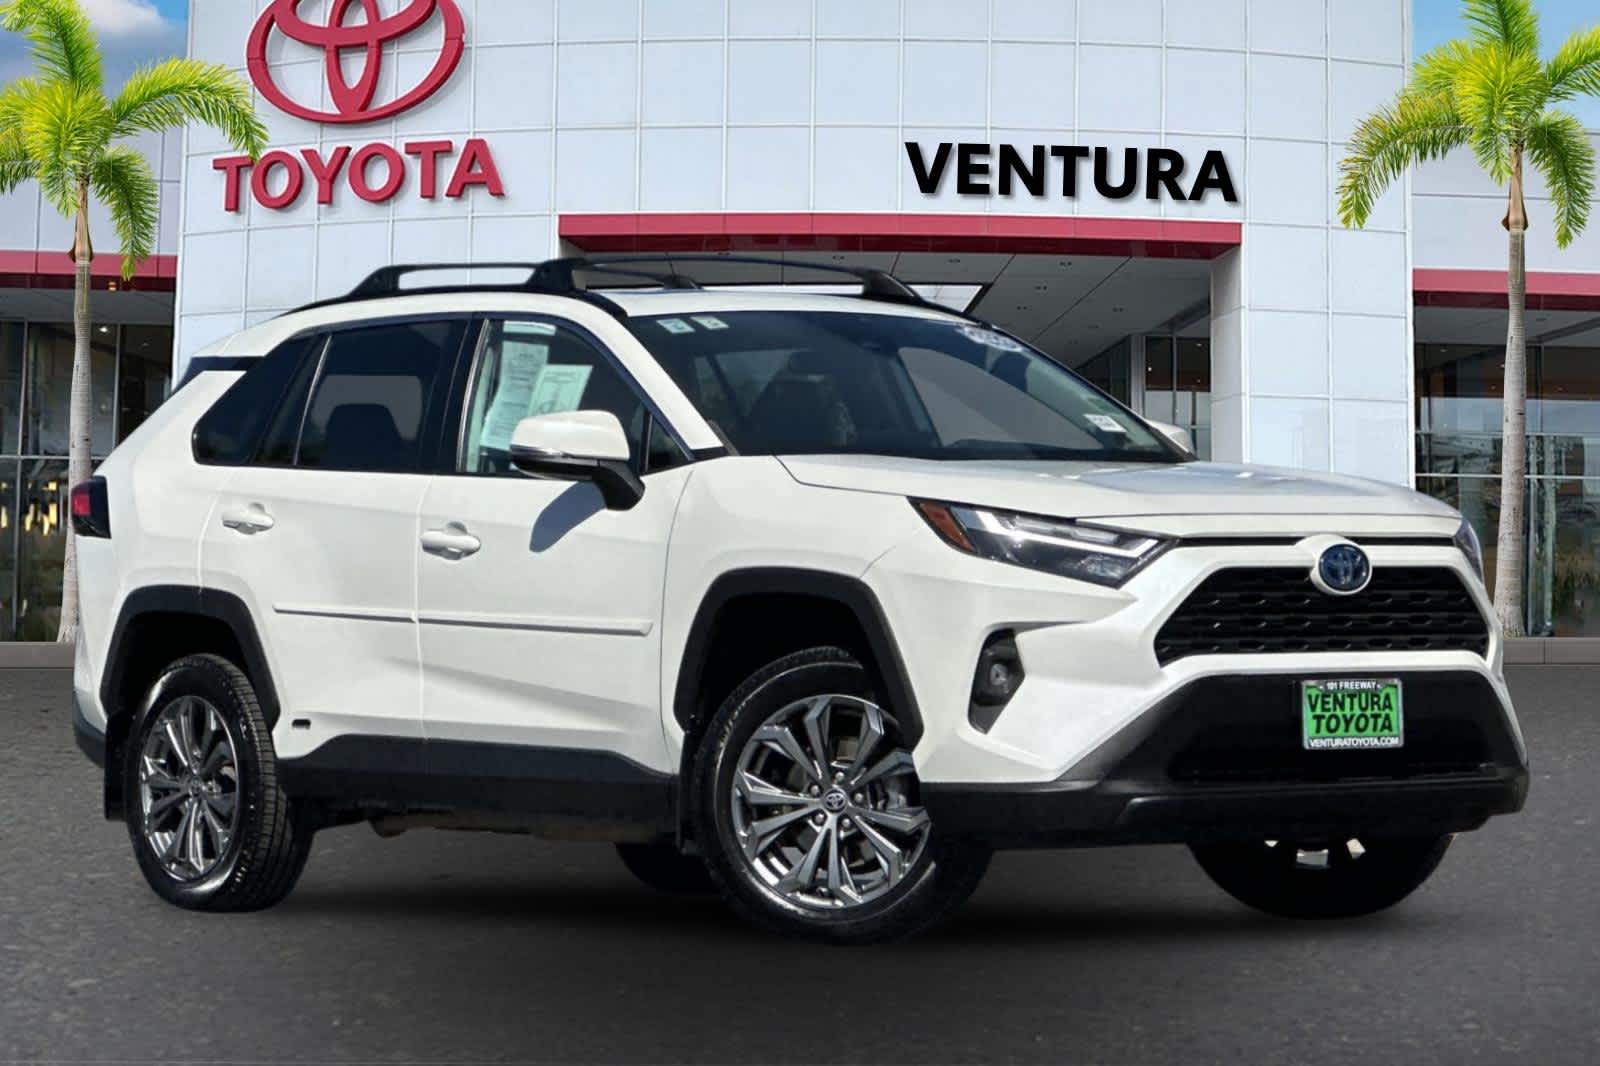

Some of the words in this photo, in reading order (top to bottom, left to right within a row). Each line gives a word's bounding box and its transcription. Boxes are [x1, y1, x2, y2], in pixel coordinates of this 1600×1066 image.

[212, 138, 505, 212] TOYOTA
[904, 141, 1239, 203] VENTURA
[1340, 681, 1377, 690] FREEWAY
[1307, 692, 1392, 712] VENTURA
[1312, 714, 1392, 733] TOYOTA
[1310, 737, 1399, 747] VENTURATOYOTA.COM
